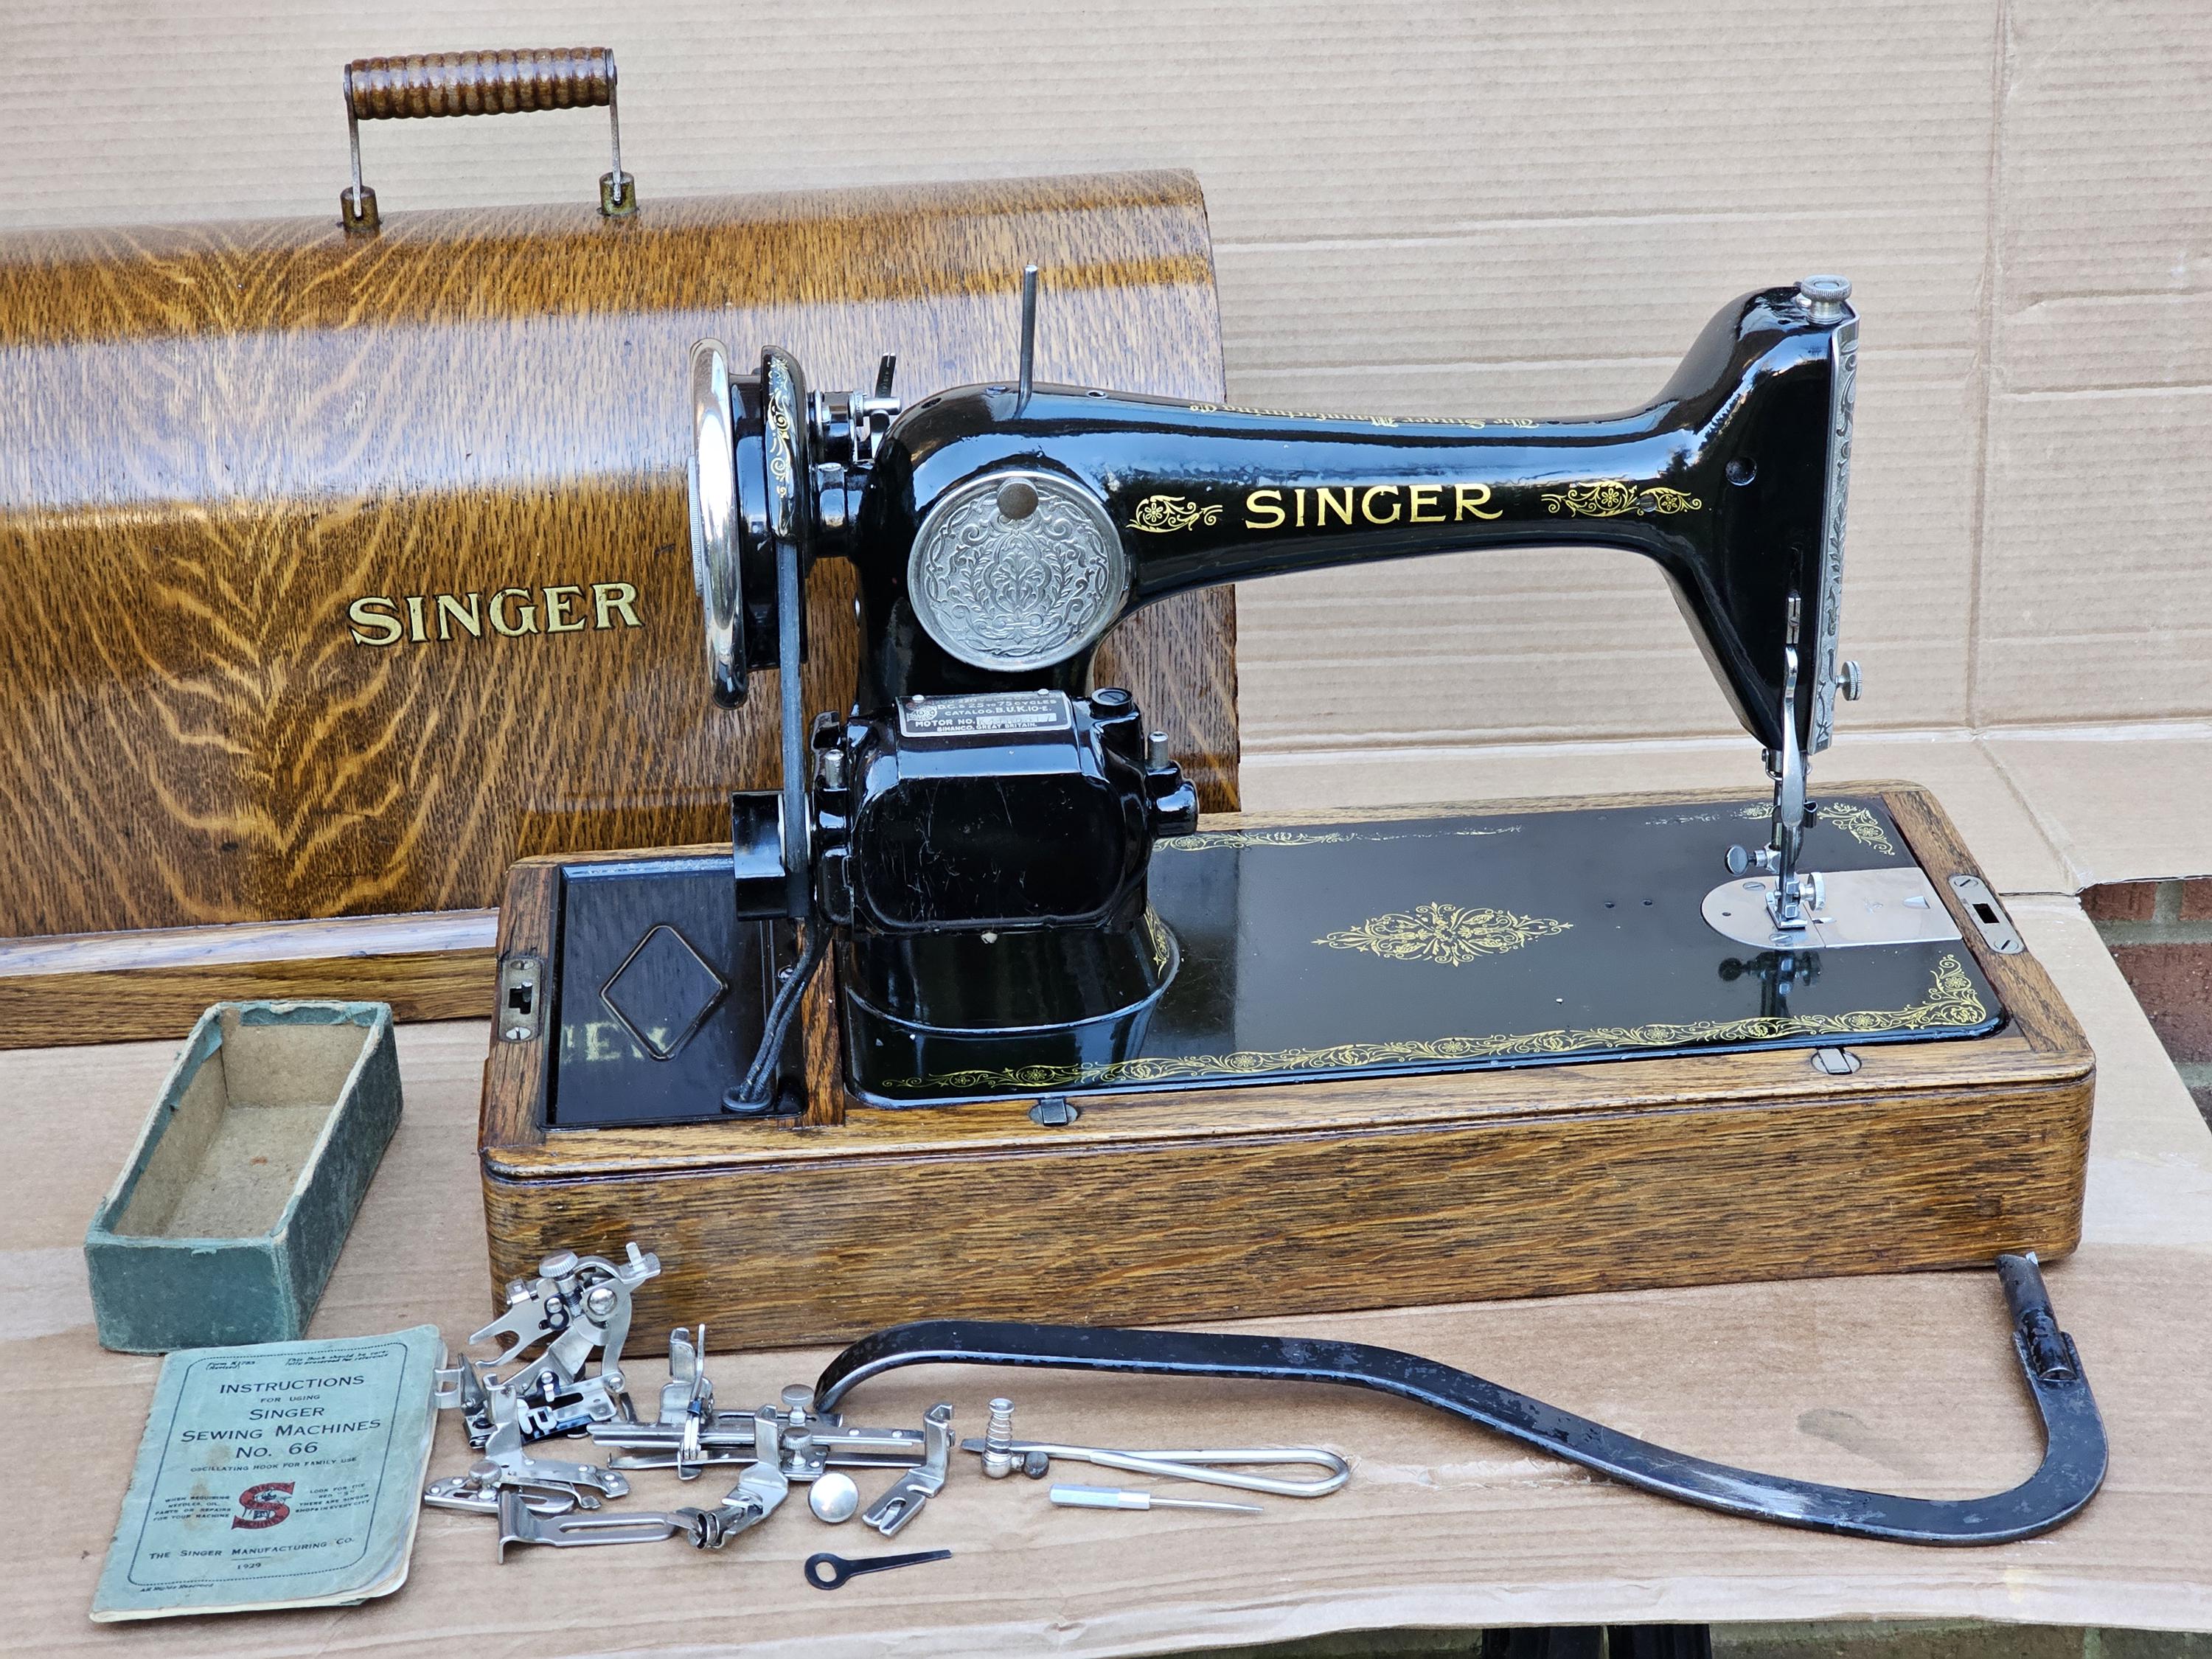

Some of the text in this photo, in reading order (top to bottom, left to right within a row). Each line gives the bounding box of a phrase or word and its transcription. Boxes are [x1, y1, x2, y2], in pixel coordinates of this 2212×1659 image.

[1245, 483, 1503, 531] SINGER
[348, 582, 644, 647] SINGER
[915, 719, 953, 728] MOTOR
[220, 1375, 365, 1394] INSTRUCTIONS
[249, 1407, 325, 1421] SINGER
[181, 1419, 381, 1442] SEWING MACHINES
[288, 1441, 319, 1455] 66
[149, 1551, 171, 1560] THE
[232, 1541, 327, 1556] MANUFACTURING
[237, 1562, 262, 1570] 1929
